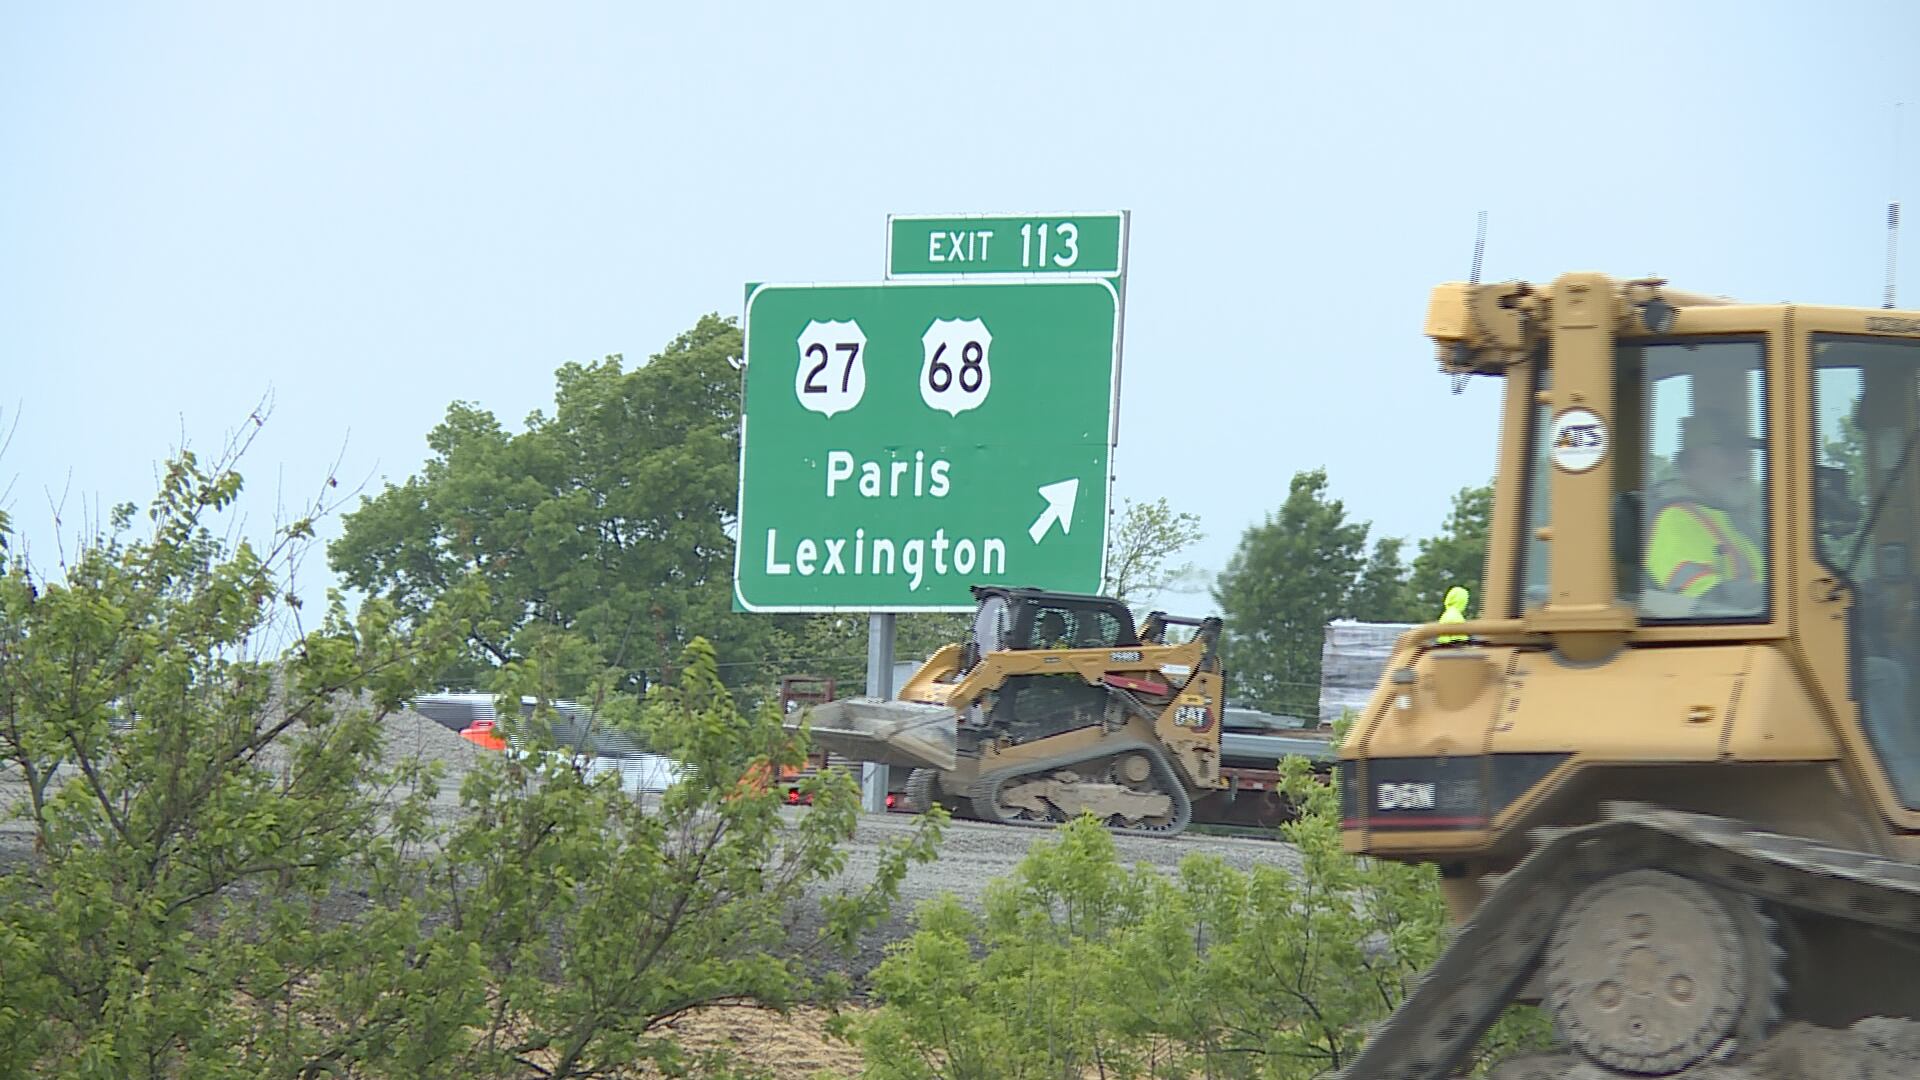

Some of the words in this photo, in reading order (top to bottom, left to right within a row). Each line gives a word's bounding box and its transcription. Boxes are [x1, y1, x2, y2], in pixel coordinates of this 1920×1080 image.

[929, 231, 994, 262] EXIT
[1021, 222, 1079, 267] 113
[803, 342, 859, 394] 27
[928, 340, 983, 393] 68
[1552, 425, 1602, 448] ATS
[826, 450, 950, 497] Paris
[766, 528, 1006, 591] Lexington
[1174, 707, 1207, 726] CAT
